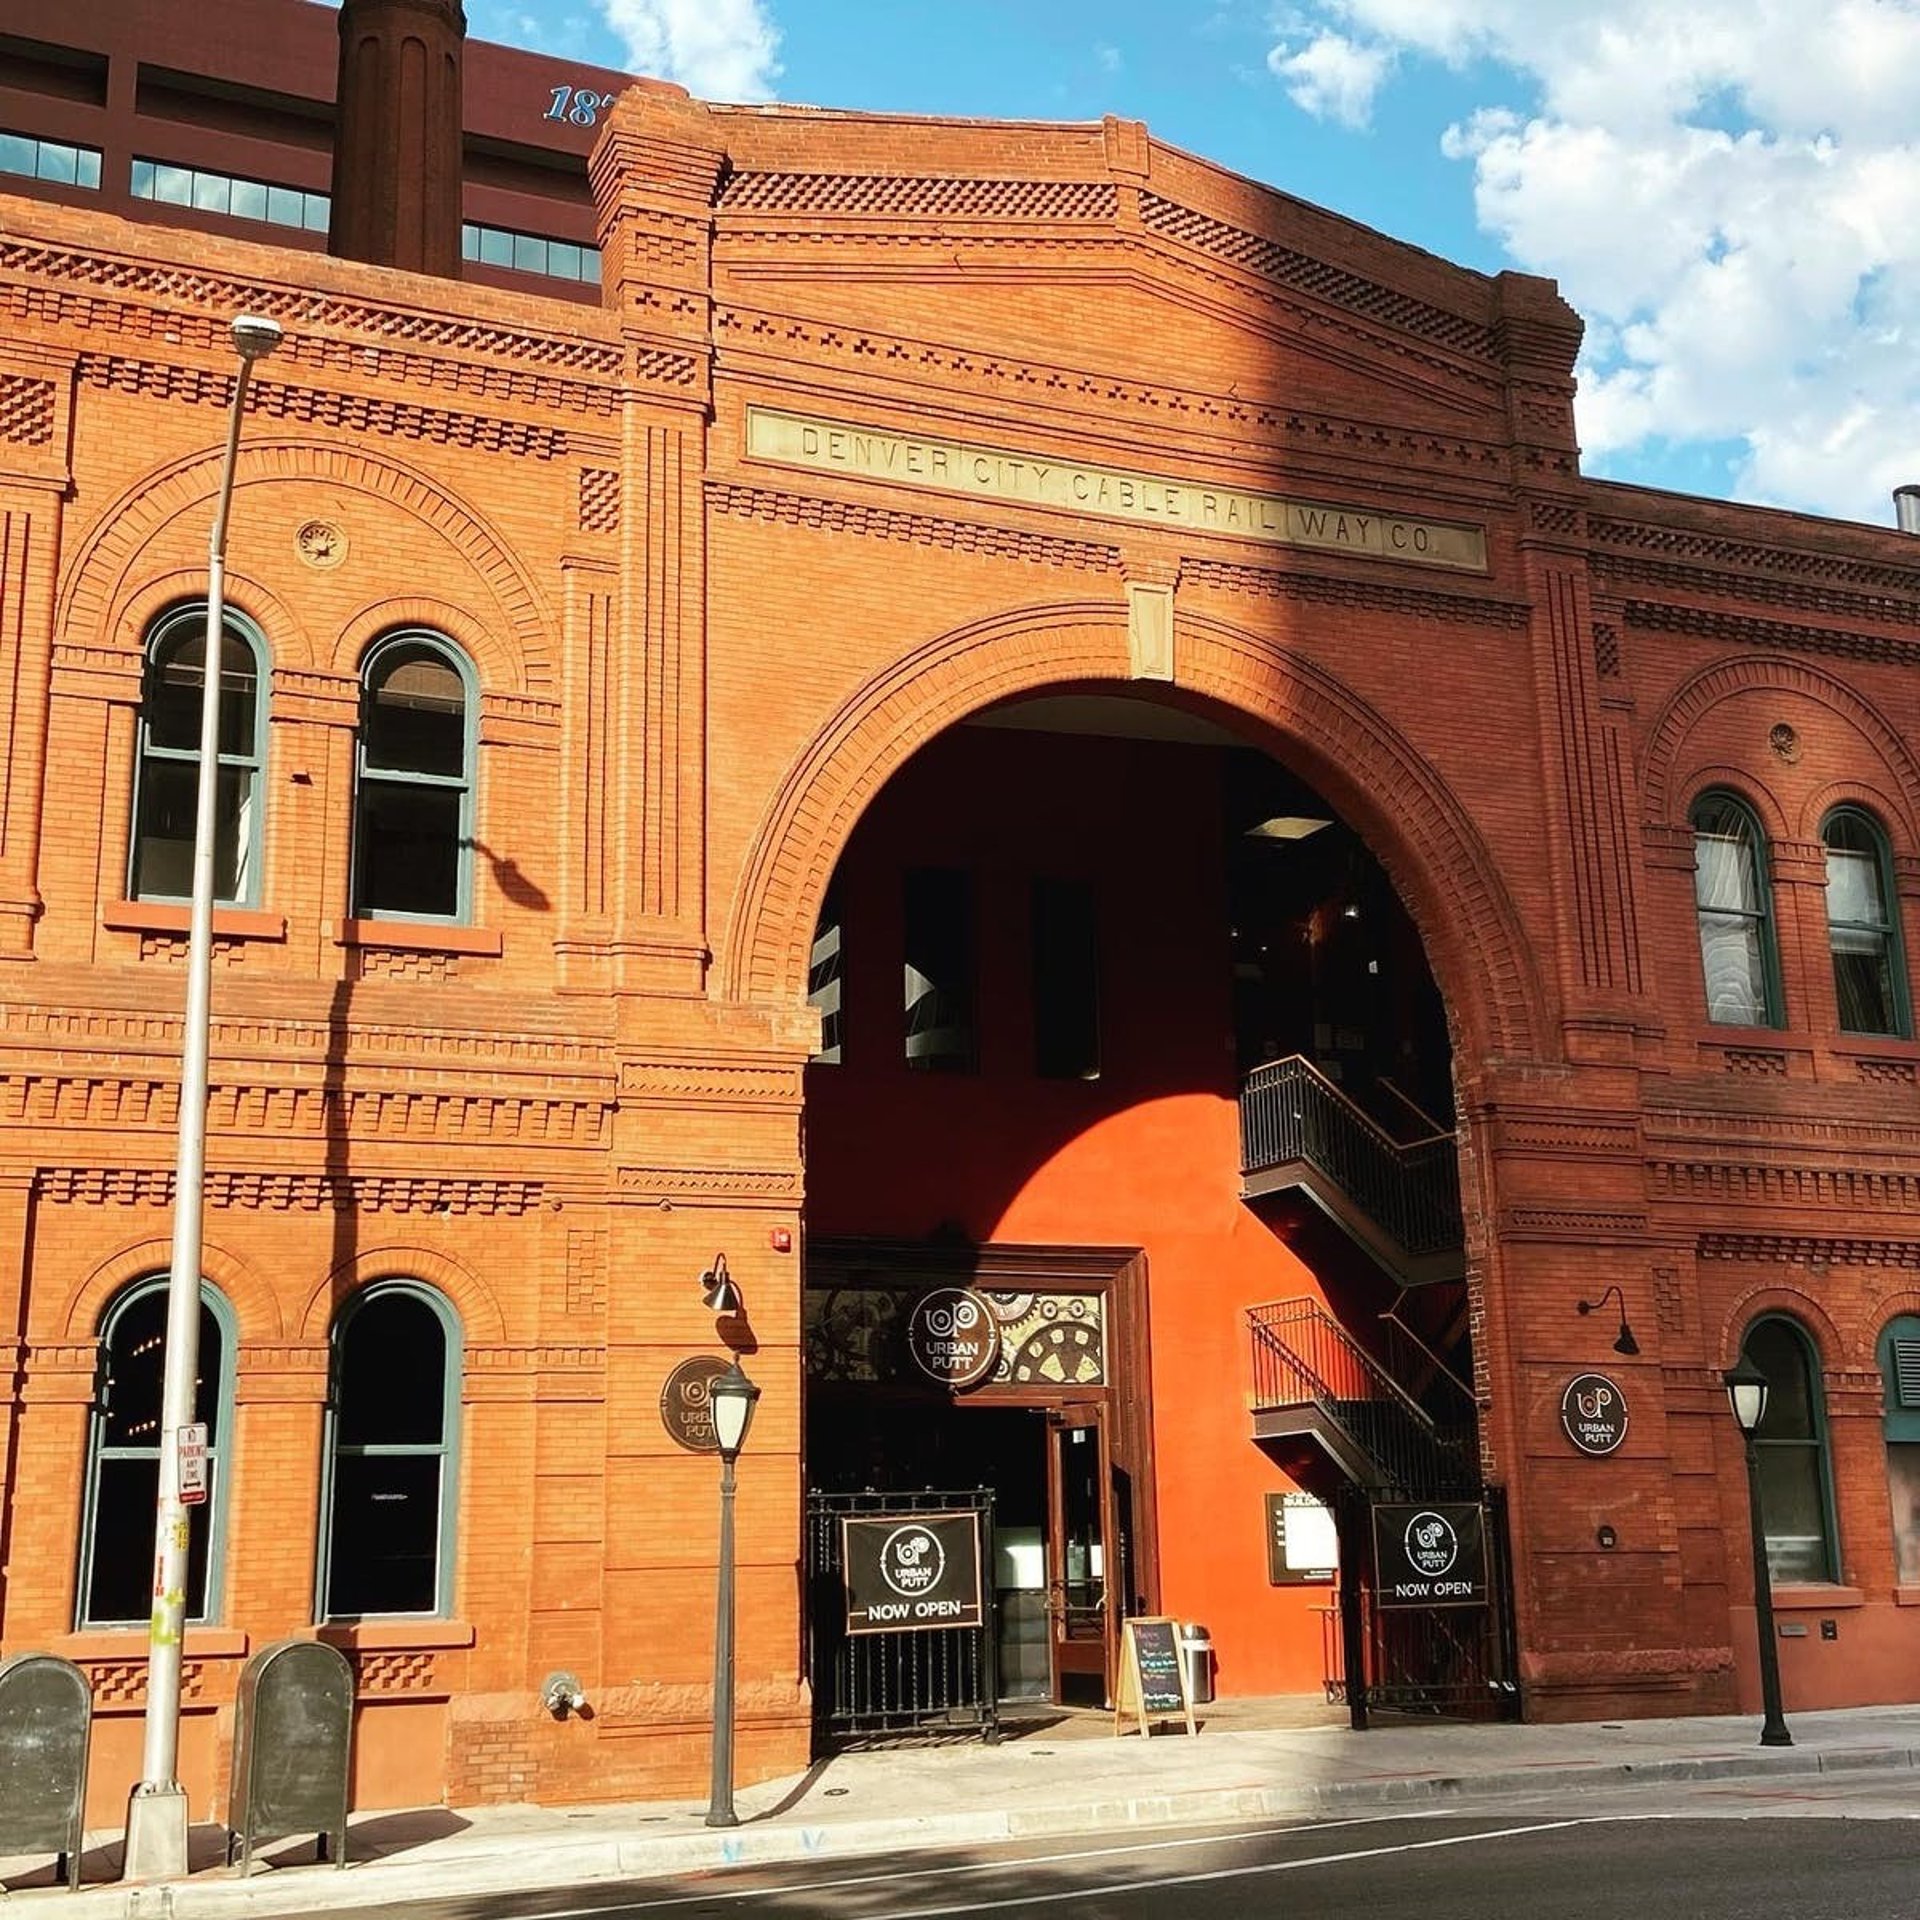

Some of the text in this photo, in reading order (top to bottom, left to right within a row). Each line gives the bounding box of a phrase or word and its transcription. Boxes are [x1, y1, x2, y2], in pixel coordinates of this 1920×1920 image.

[802, 428, 948, 479] DENVER
[973, 457, 1050, 488] CITY
[1073, 474, 1181, 515] CABLE
[925, 1341, 979, 1355] URBAN
[932, 1356, 974, 1370] PUTT
[680, 1411, 713, 1424] URB
[1578, 1422, 1615, 1433] URBAN
[1584, 1433, 1612, 1444] PUTT
[1417, 1551, 1447, 1560] URBAN
[1422, 1559, 1446, 1568] PUTT
[895, 1567, 932, 1579] URBAN
[901, 1577, 929, 1588] PUTT
[1395, 1581, 1472, 1597] NOW OPEN
[868, 1600, 962, 1621] NOW OPEN
